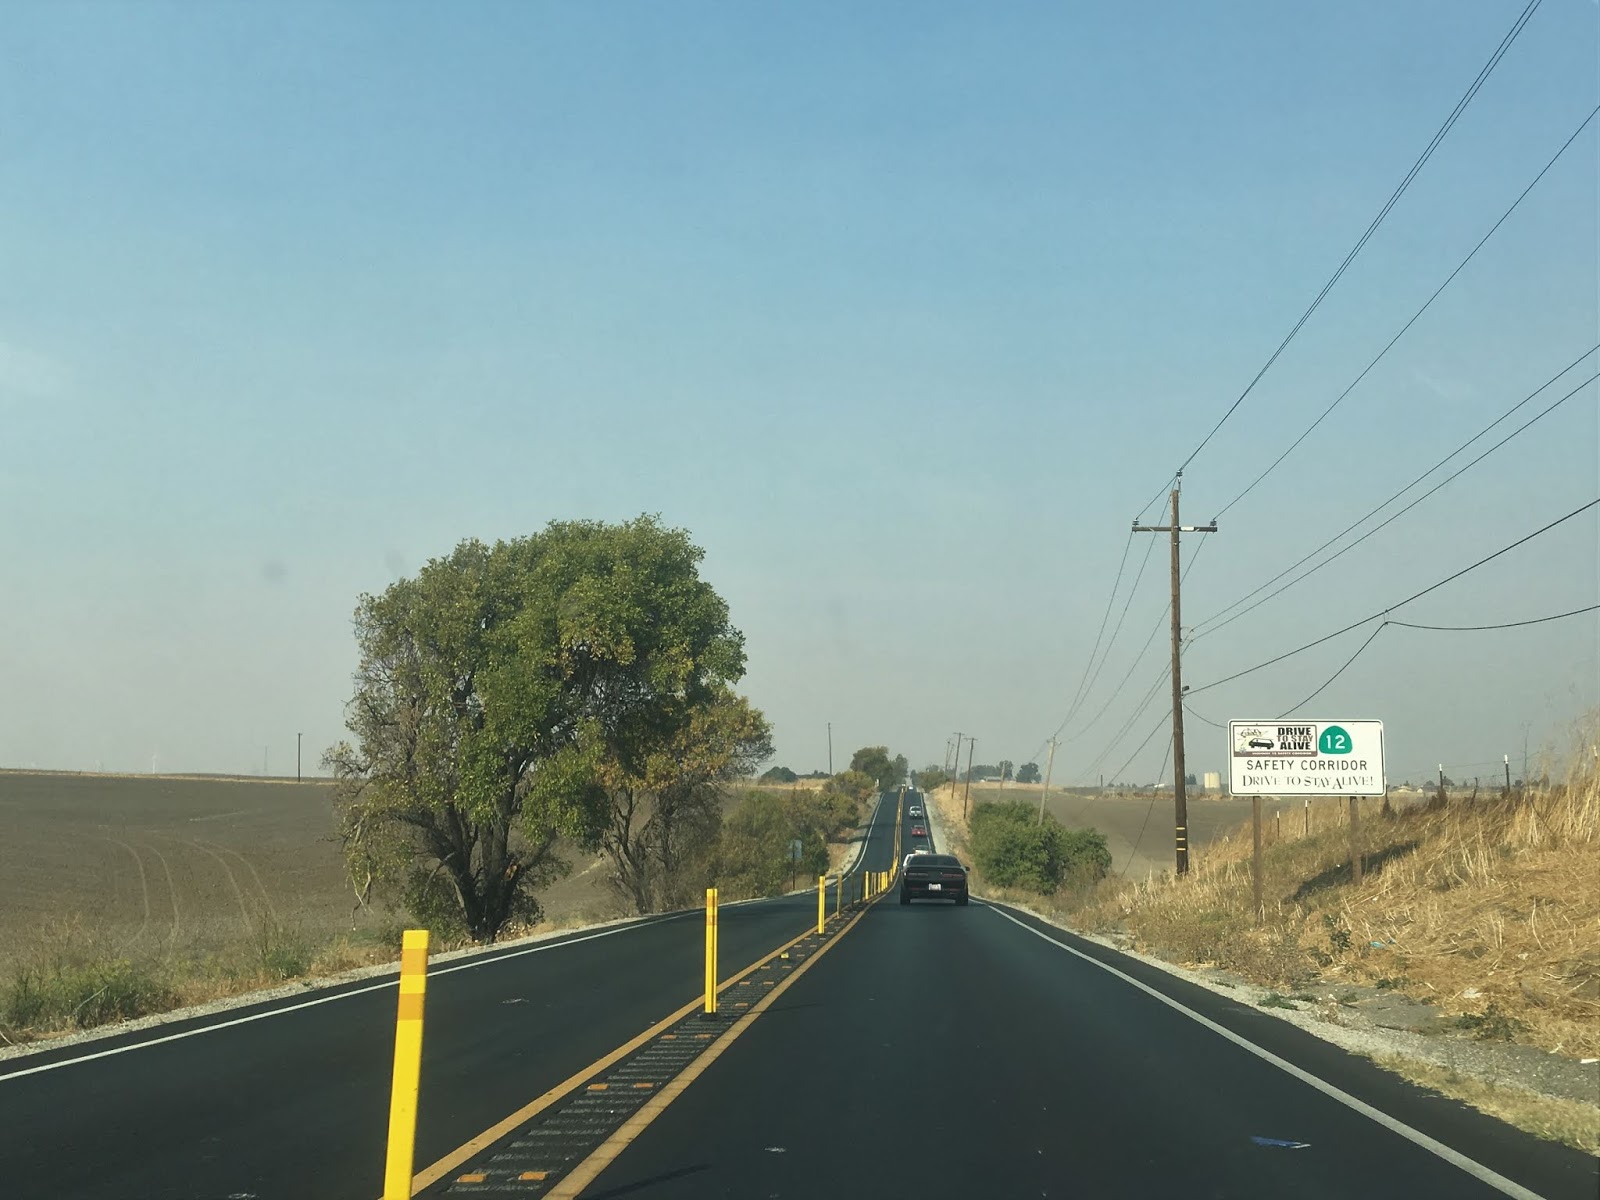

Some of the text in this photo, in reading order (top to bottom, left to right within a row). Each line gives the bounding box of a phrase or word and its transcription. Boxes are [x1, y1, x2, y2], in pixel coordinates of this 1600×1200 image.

[1278, 727, 1311, 735] DRIVE
[1280, 742, 1311, 750] ALIVE
[1326, 735, 1346, 749] 12
[1246, 760, 1367, 770] SAFETY CORRIDOR
[1242, 775, 1280, 786] DRIVE
[1286, 776, 1301, 786] TO
[1304, 776, 1332, 787] STAY
